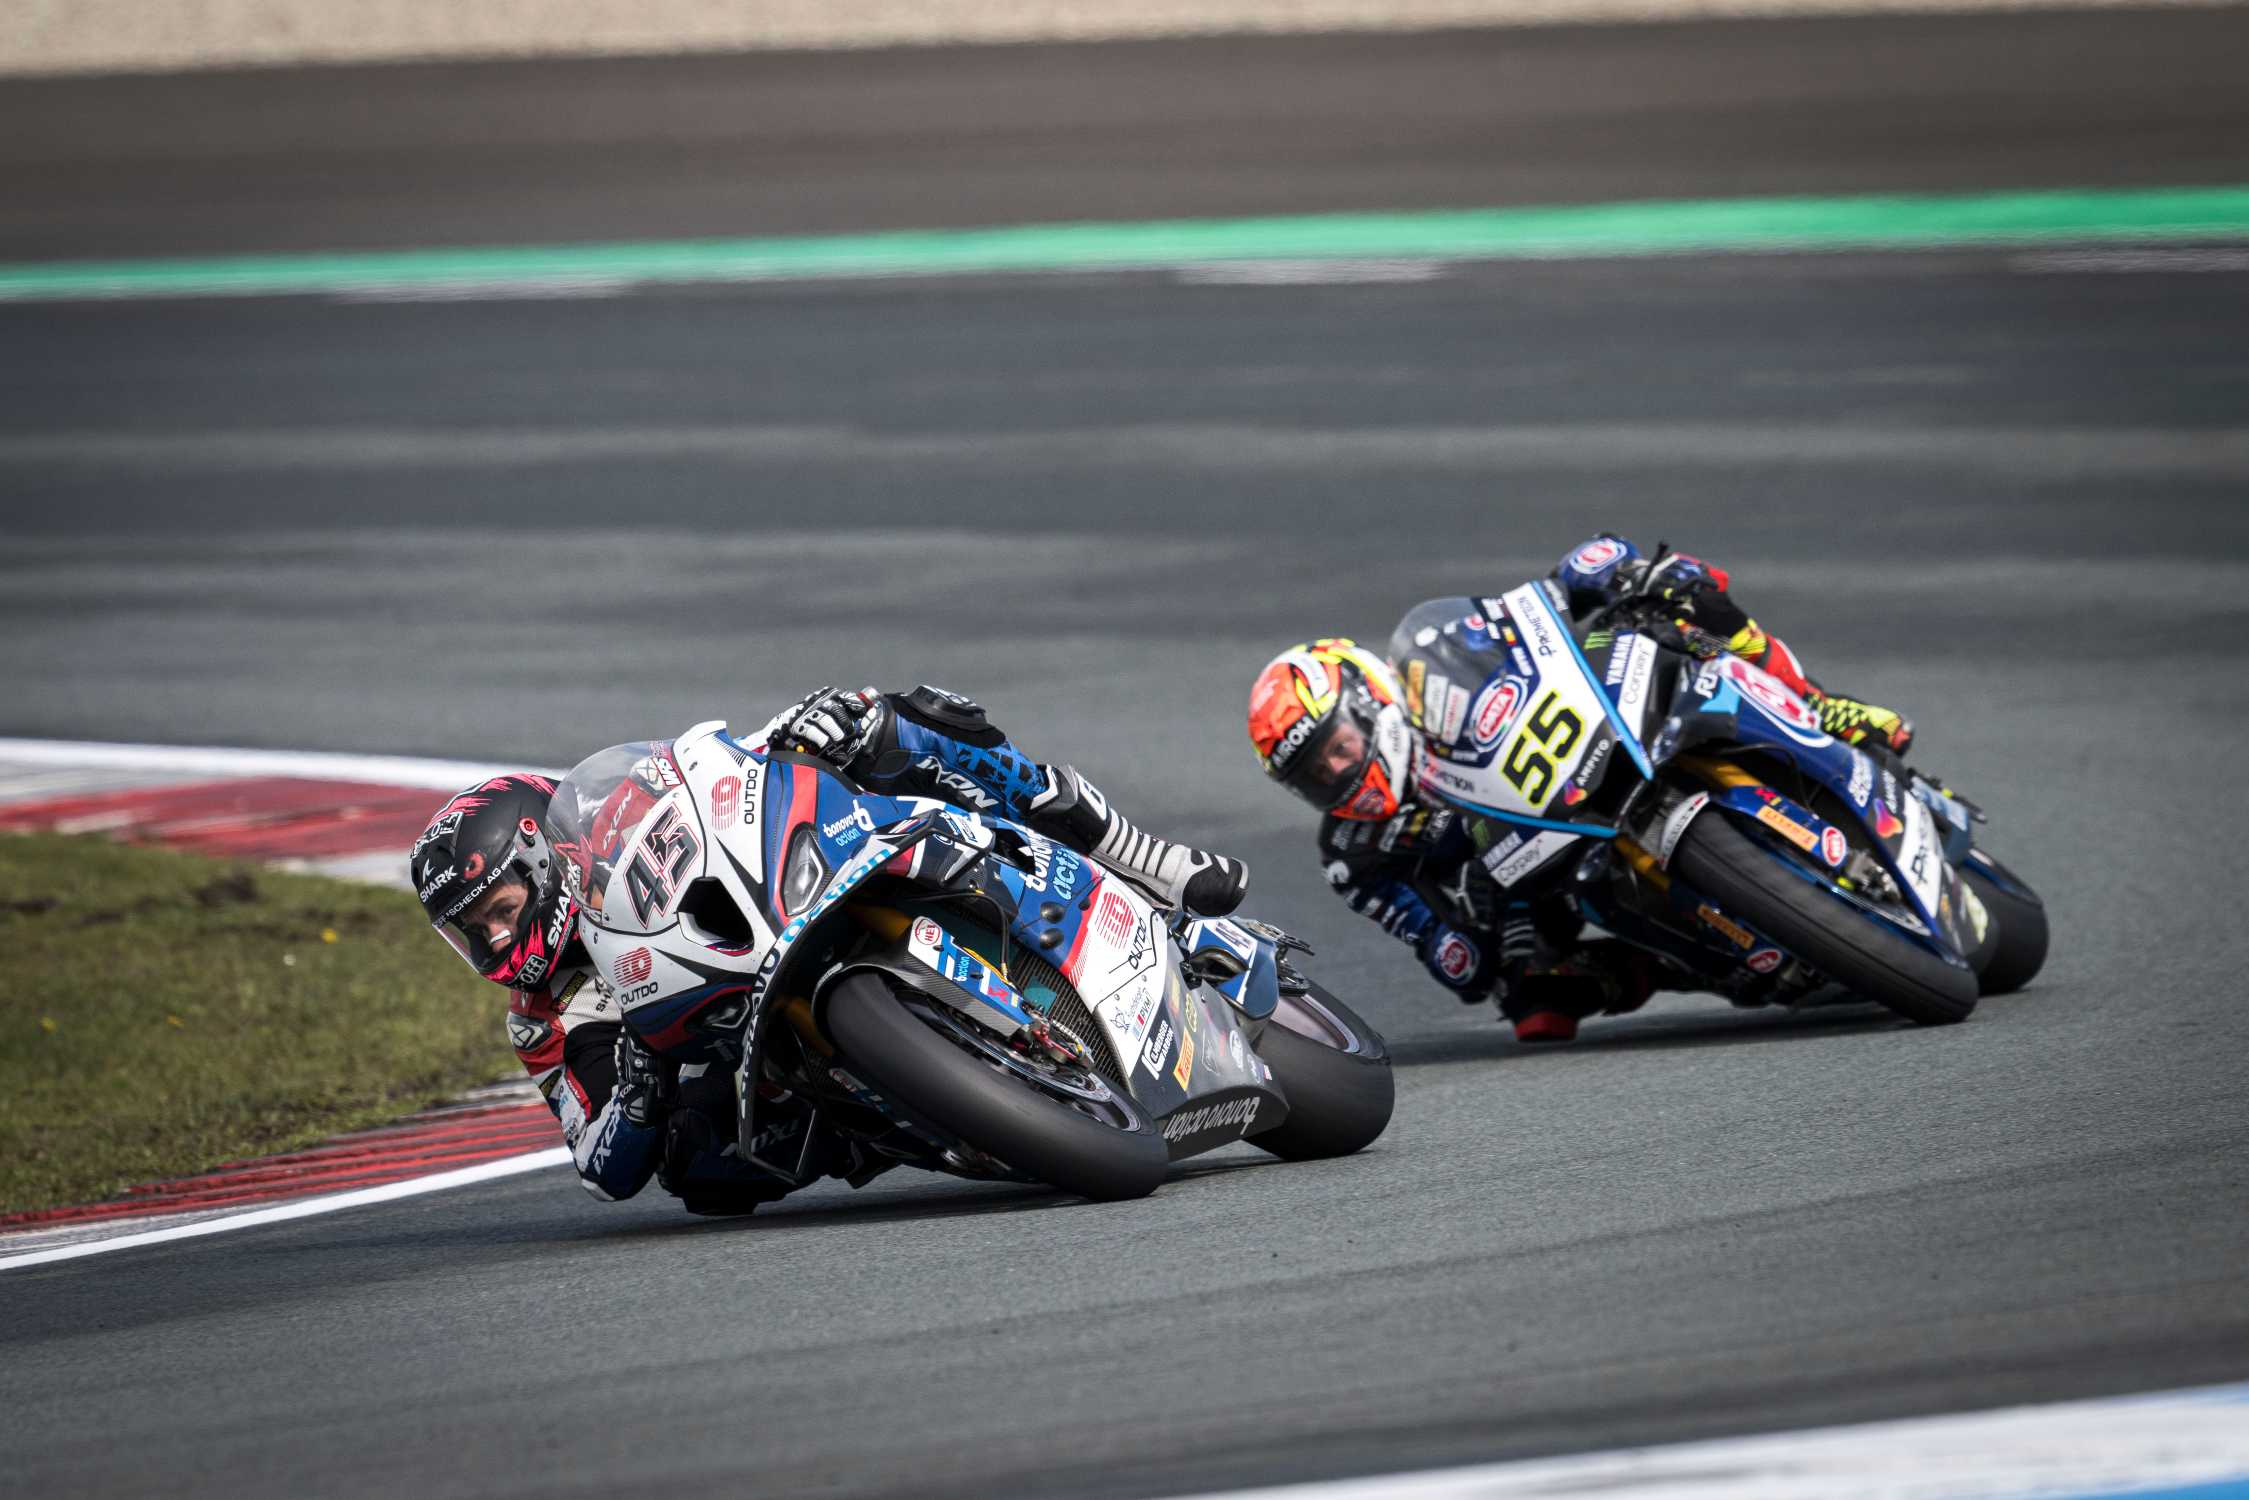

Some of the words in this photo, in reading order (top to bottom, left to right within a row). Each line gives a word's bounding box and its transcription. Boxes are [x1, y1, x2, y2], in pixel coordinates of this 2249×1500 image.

[1606, 634, 1634, 686] YAMAHA
[1272, 716, 1316, 767] AIROH
[1501, 689, 1585, 808] 55
[1577, 739, 1610, 786] AMPITO
[744, 768, 758, 825] OUTDO
[823, 814, 854, 838] bonovo
[835, 828, 862, 847] action
[419, 864, 459, 903] SHARK
[486, 866, 503, 886] AG
[624, 801, 701, 930] 45
[1128, 917, 1147, 970] OUTDO
[621, 981, 659, 1005] OUTDO
